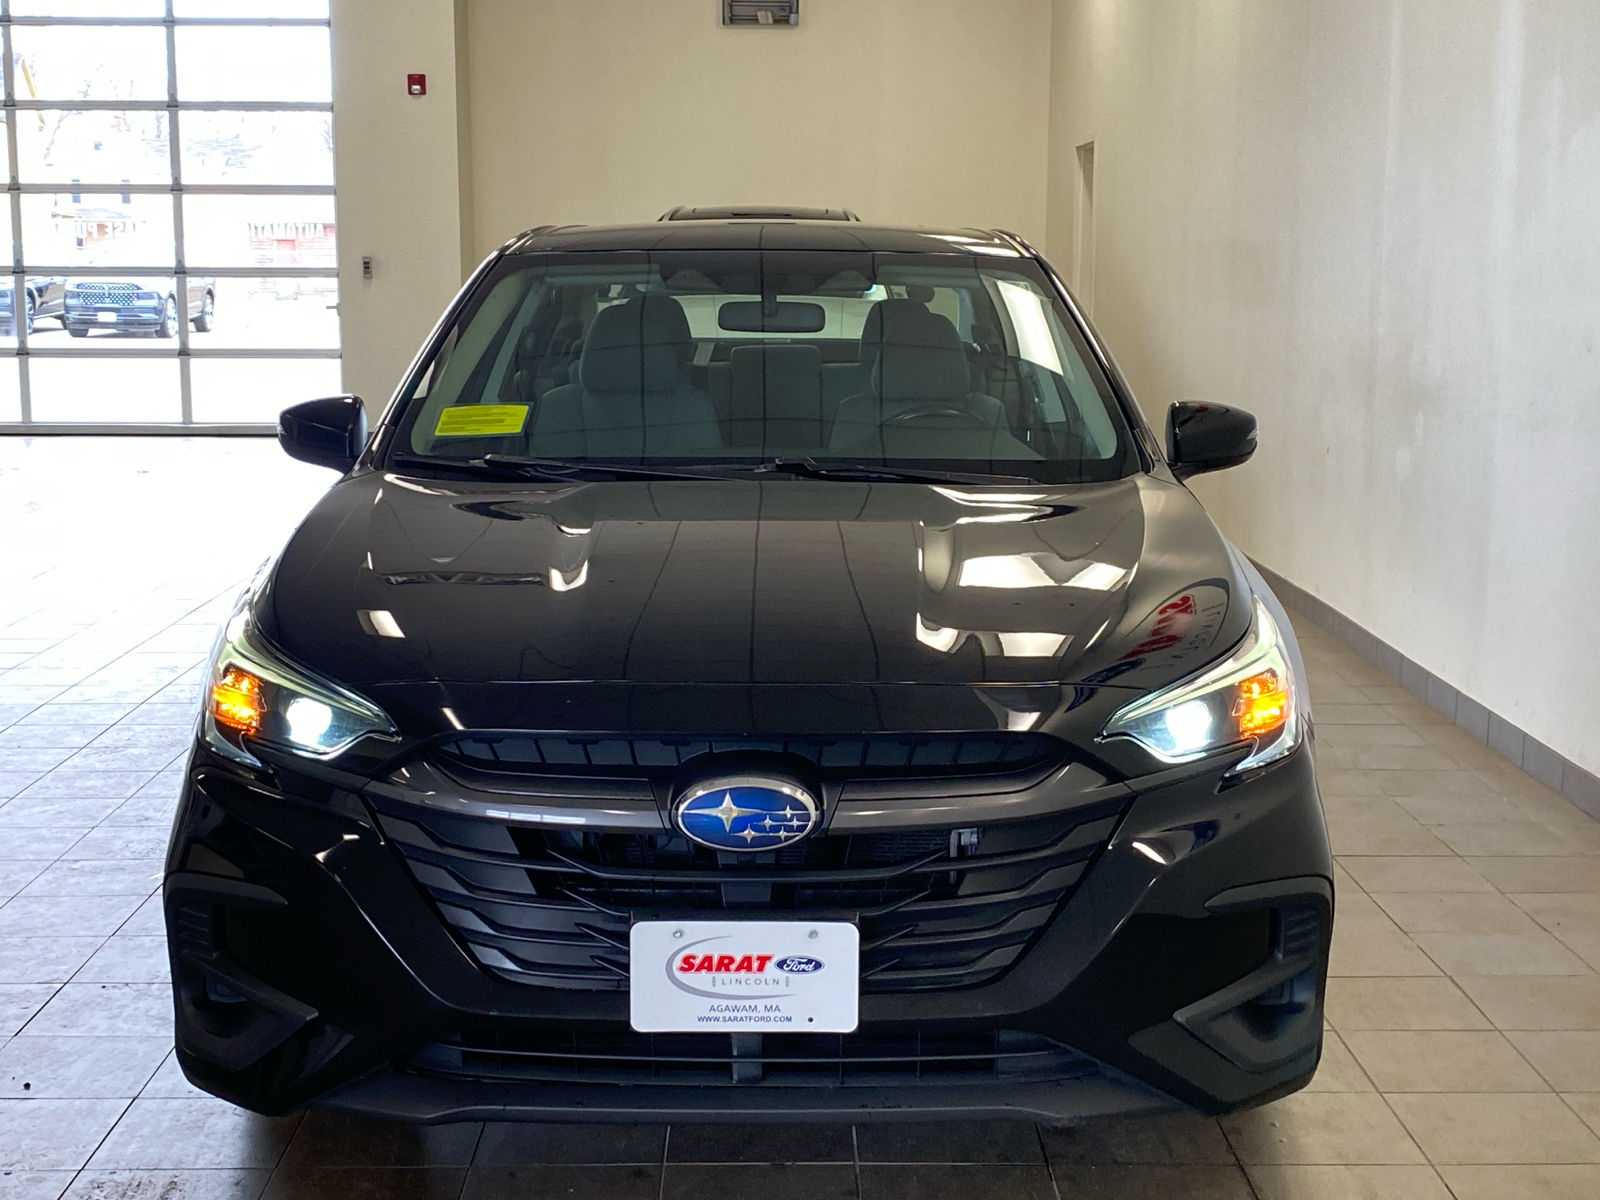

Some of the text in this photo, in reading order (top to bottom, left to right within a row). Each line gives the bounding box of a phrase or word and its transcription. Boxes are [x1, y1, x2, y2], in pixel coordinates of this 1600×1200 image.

[676, 953, 818, 974] SARAT Ford
[721, 977, 780, 986] LINCOLN
[708, 1004, 781, 1014] AGAWAM, MA
[697, 1015, 793, 1023] WWW.SARATFORD.COM
